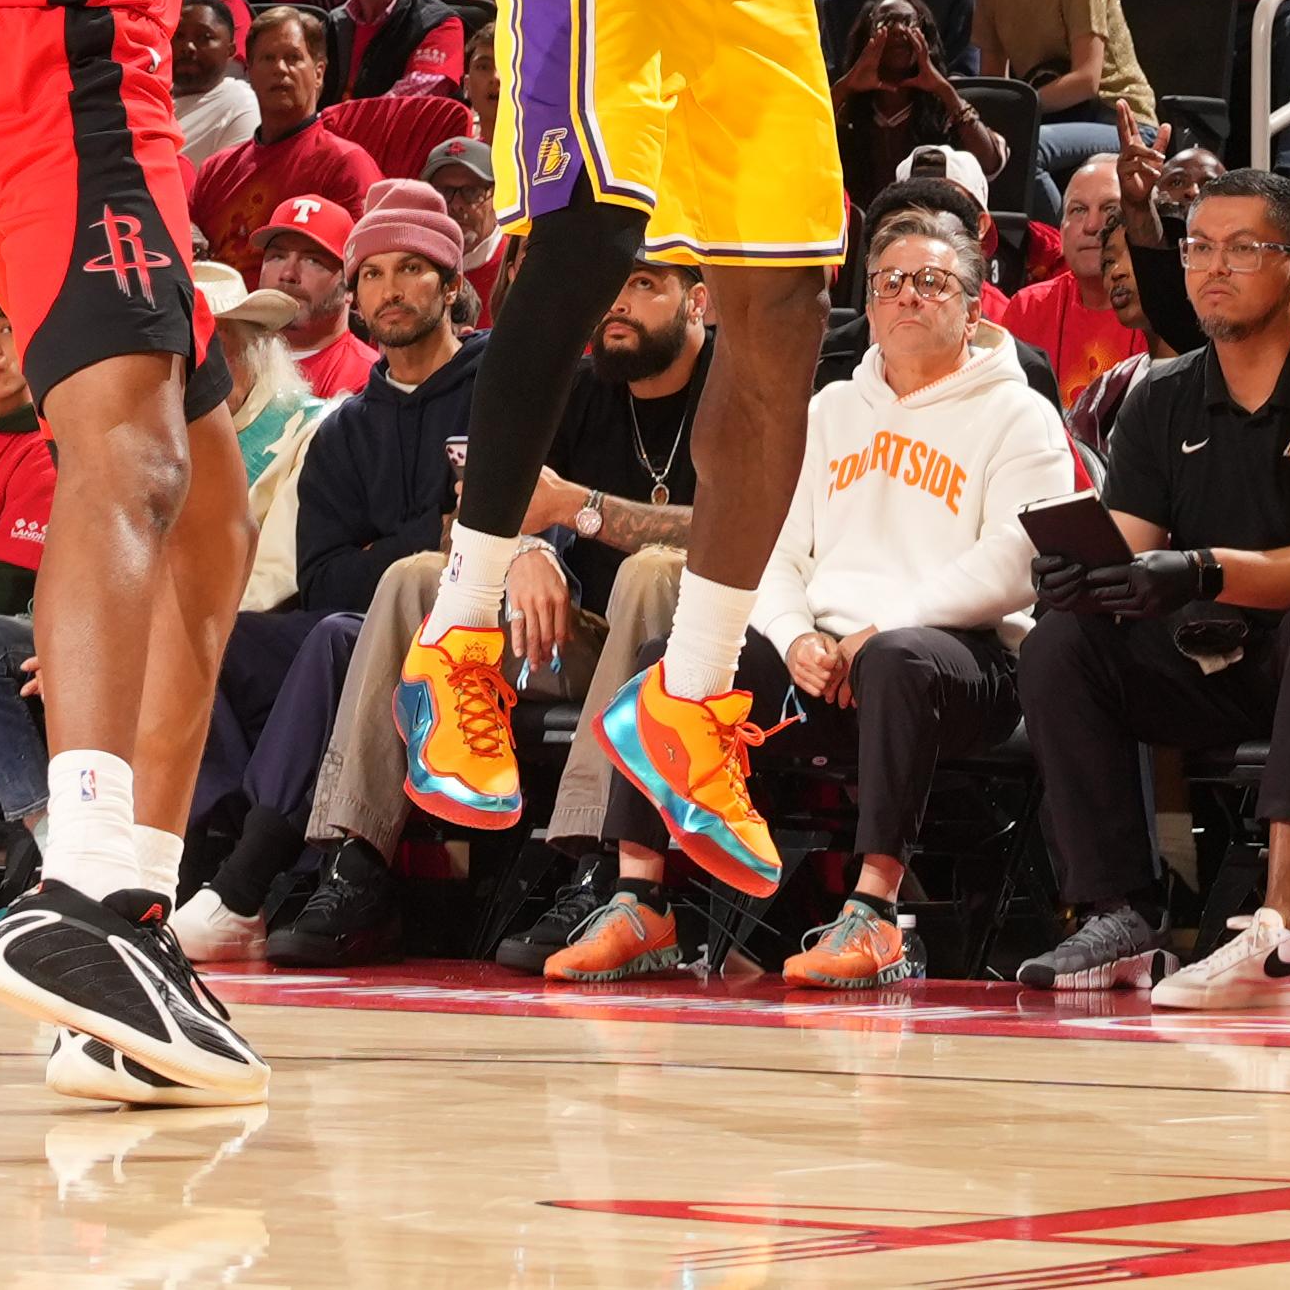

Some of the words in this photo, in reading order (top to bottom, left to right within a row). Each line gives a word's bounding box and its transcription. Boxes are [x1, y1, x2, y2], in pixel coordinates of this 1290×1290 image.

[292, 199, 321, 224] T
[991, 258, 1000, 285] 3
[827, 430, 968, 516] COURTSIDE
